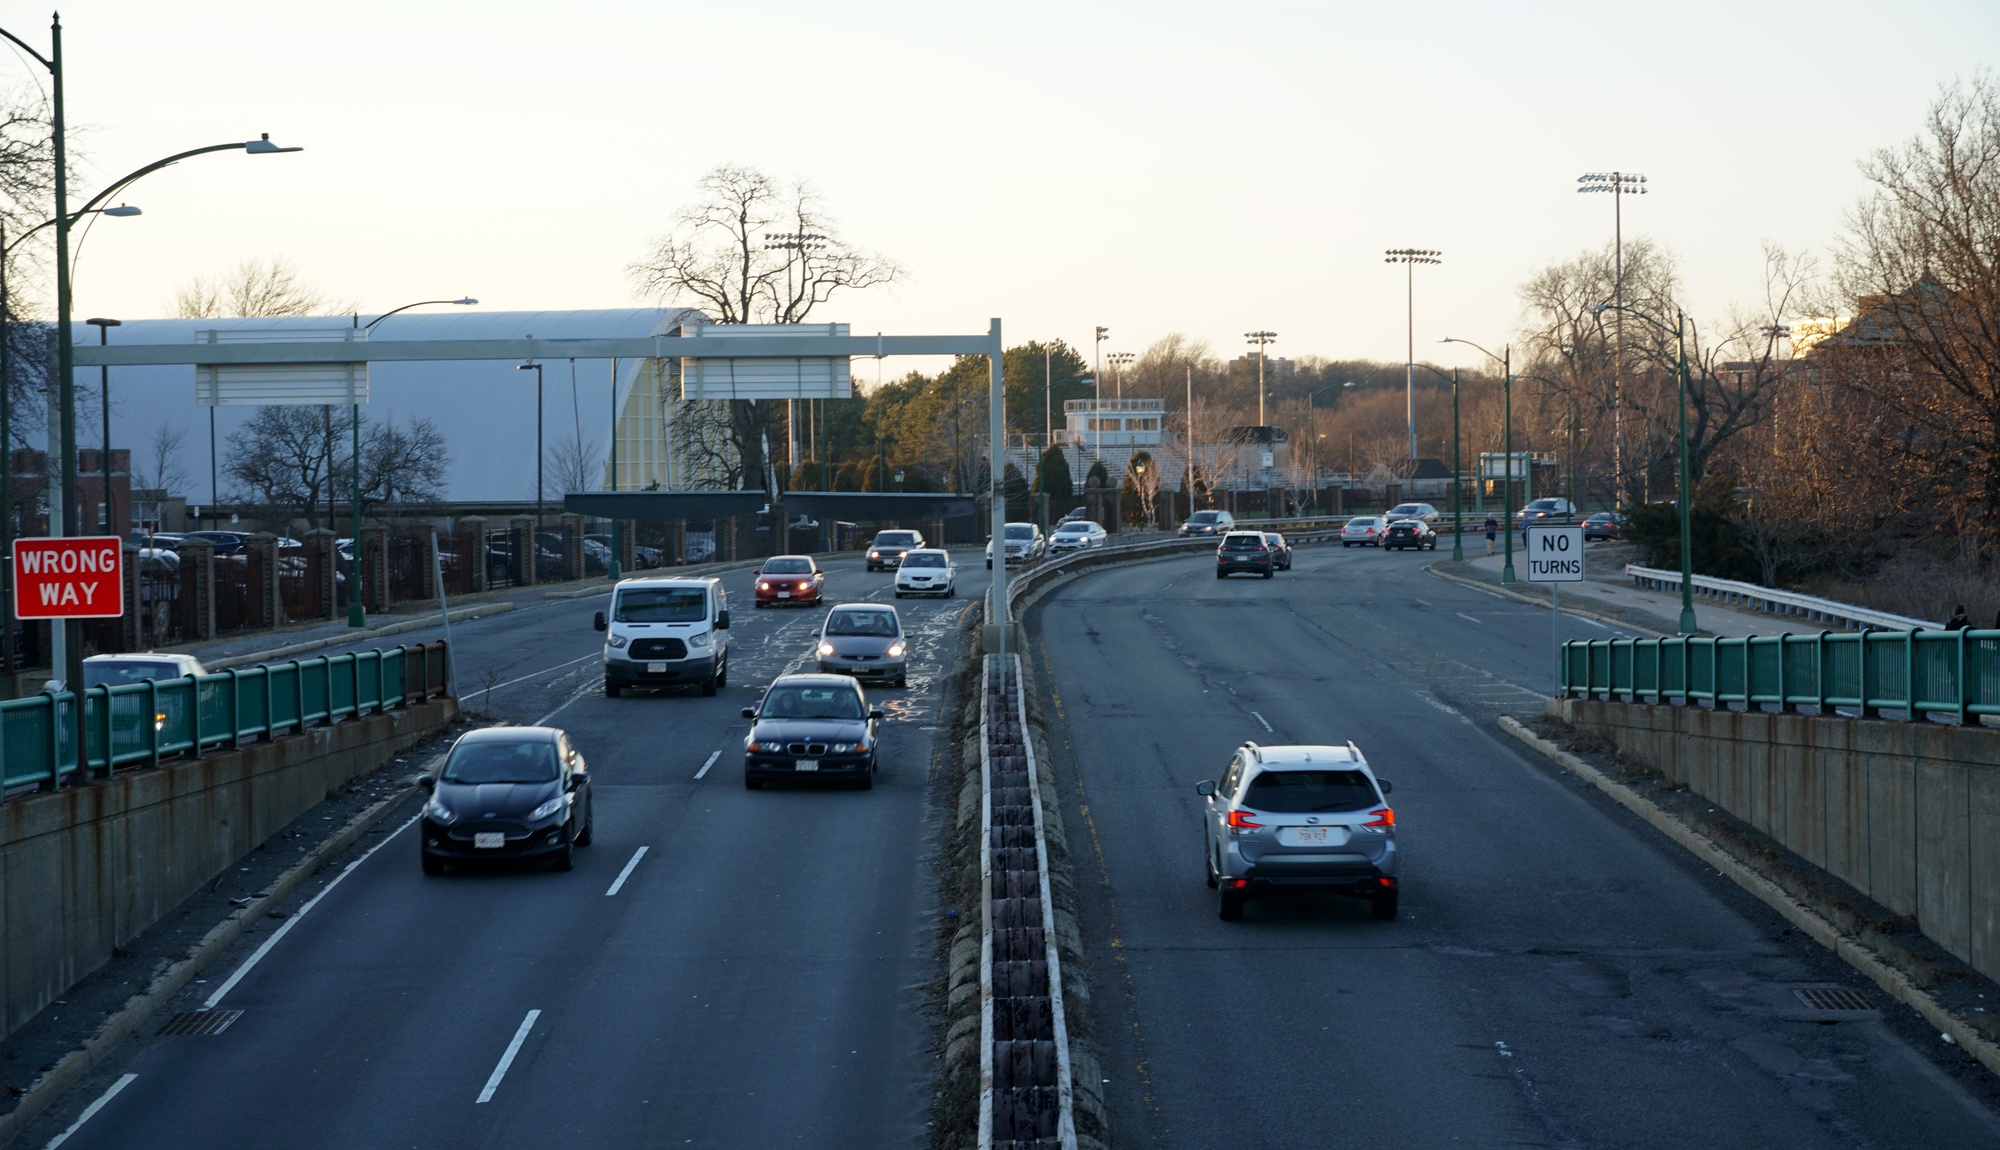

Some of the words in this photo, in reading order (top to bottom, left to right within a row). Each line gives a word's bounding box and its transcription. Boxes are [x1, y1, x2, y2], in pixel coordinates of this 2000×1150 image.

[1542, 534, 1569, 552] NO
[21, 548, 116, 575] WRONG
[1530, 560, 1581, 574] TURNS
[39, 581, 99, 606] WAY
